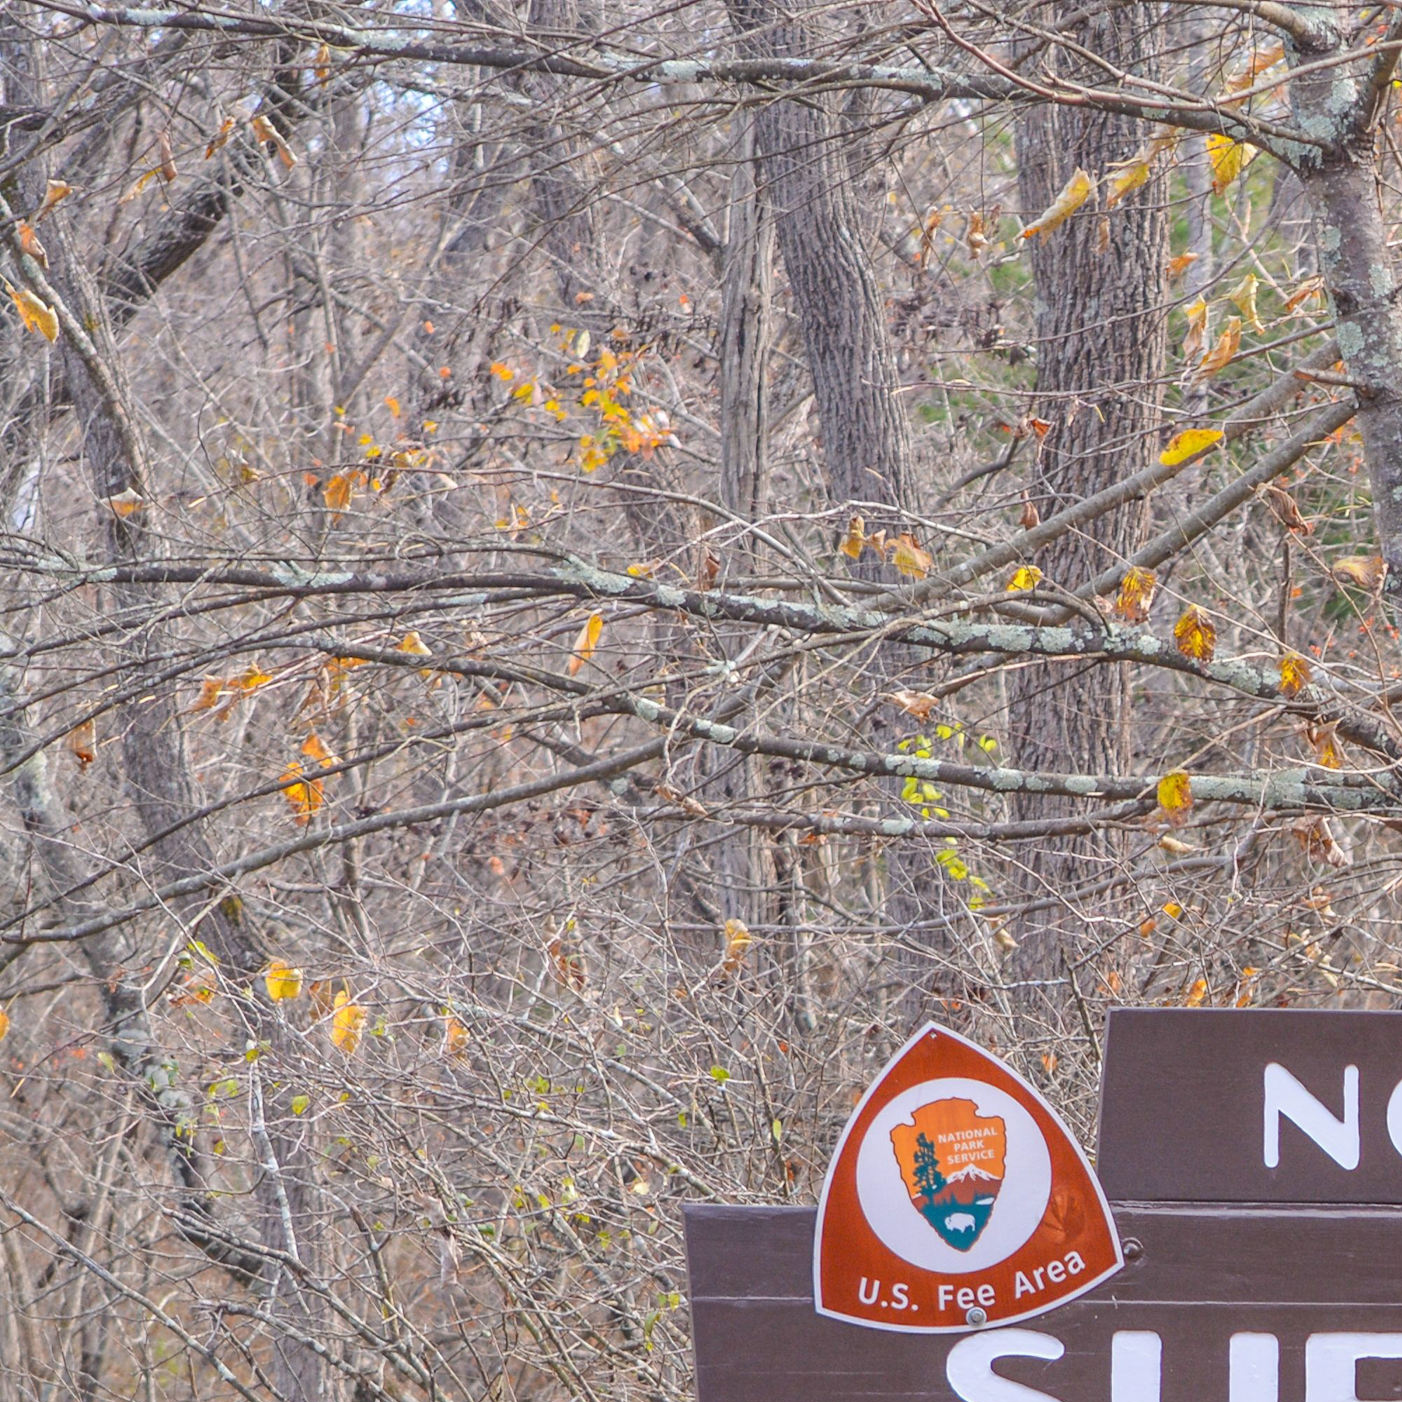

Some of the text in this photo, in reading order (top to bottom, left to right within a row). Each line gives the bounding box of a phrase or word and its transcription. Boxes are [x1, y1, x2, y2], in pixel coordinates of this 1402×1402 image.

[937, 1127, 998, 1144] NATIONAL
[953, 1140, 985, 1152] PARK
[947, 1150, 995, 1165] SERVICE
[858, 1249, 1086, 1313] U.S. Fee Area
